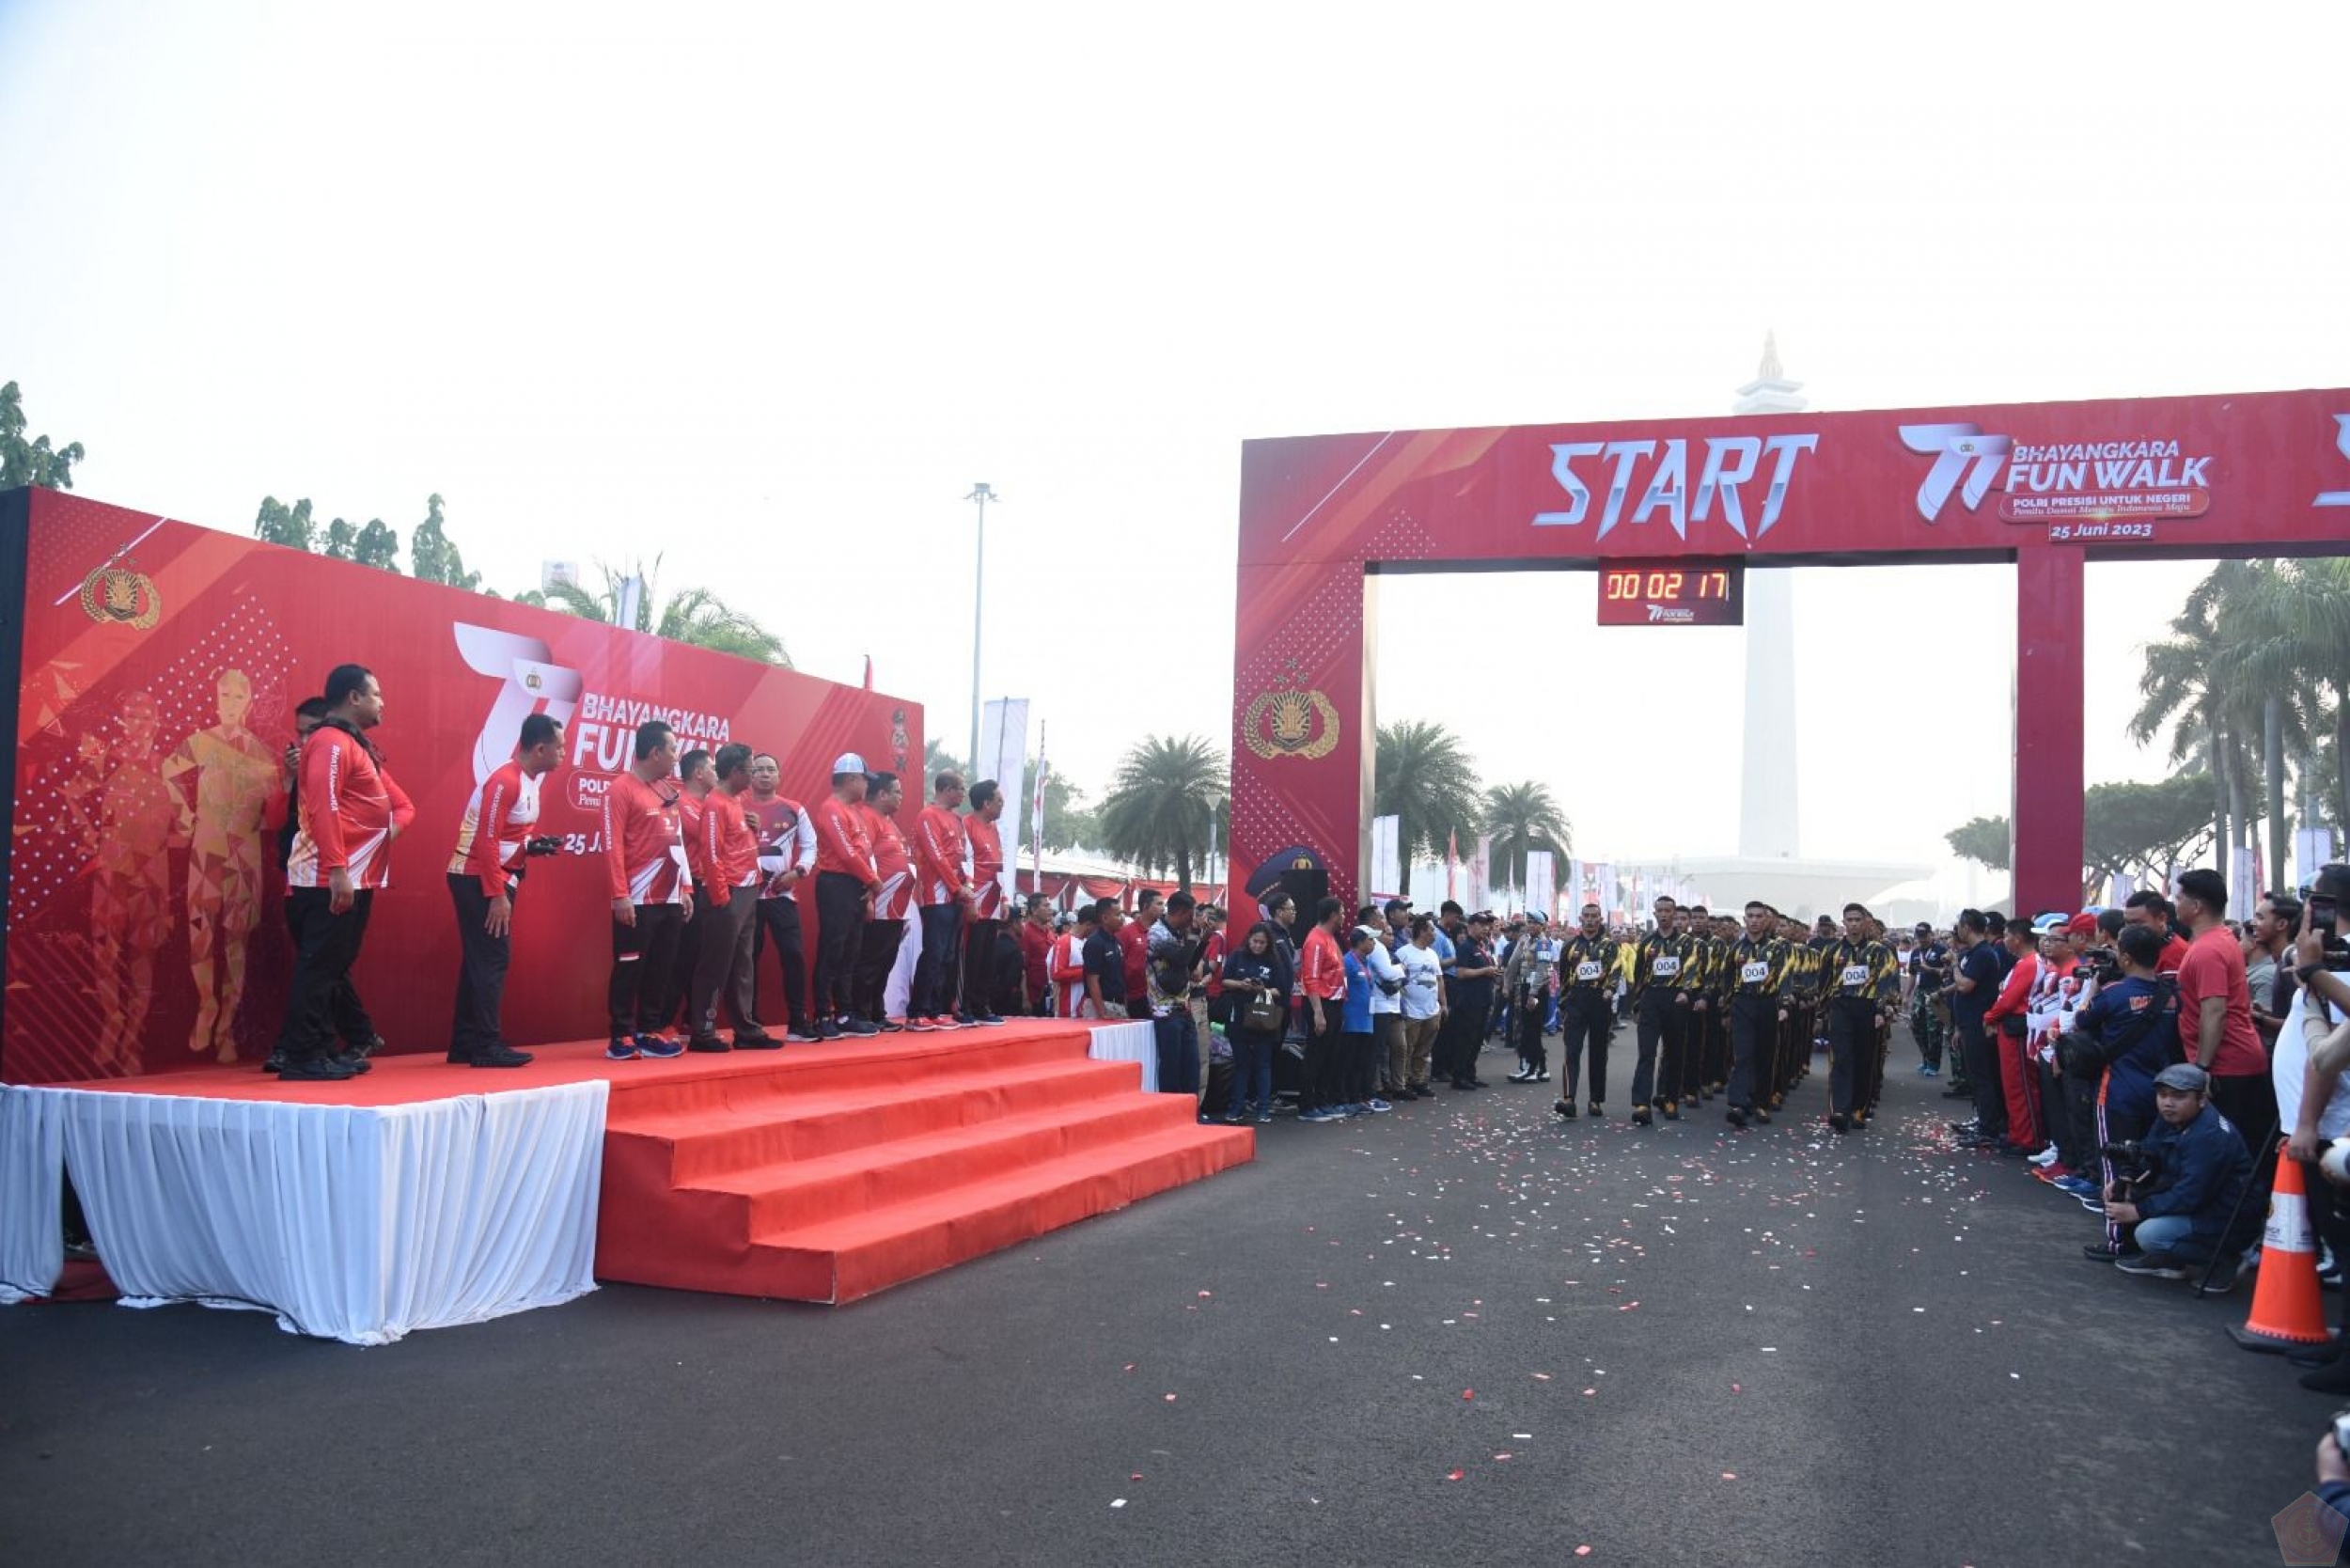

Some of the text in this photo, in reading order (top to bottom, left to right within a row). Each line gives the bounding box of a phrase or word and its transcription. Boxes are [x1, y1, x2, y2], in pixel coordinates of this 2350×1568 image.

[2013, 439, 2179, 463] BHAYANGKARA
[1899, 423, 2013, 521] 77
[2005, 456, 2211, 493] FUN WALK
[1531, 433, 1820, 542] START
[2013, 494, 2191, 508] POLRI PRESISI UNTUK NEGERI
[2051, 523, 2153, 539] 25 Juni 2023
[1608, 573, 1726, 599] 00 02 17
[582, 692, 729, 742] BHAYANGKARA
[564, 831, 602, 855] 25 J
[1580, 964, 1599, 976] 004
[1656, 961, 1677, 971] 004
[1745, 966, 1765, 978] 004
[1845, 972, 1867, 981] 004
